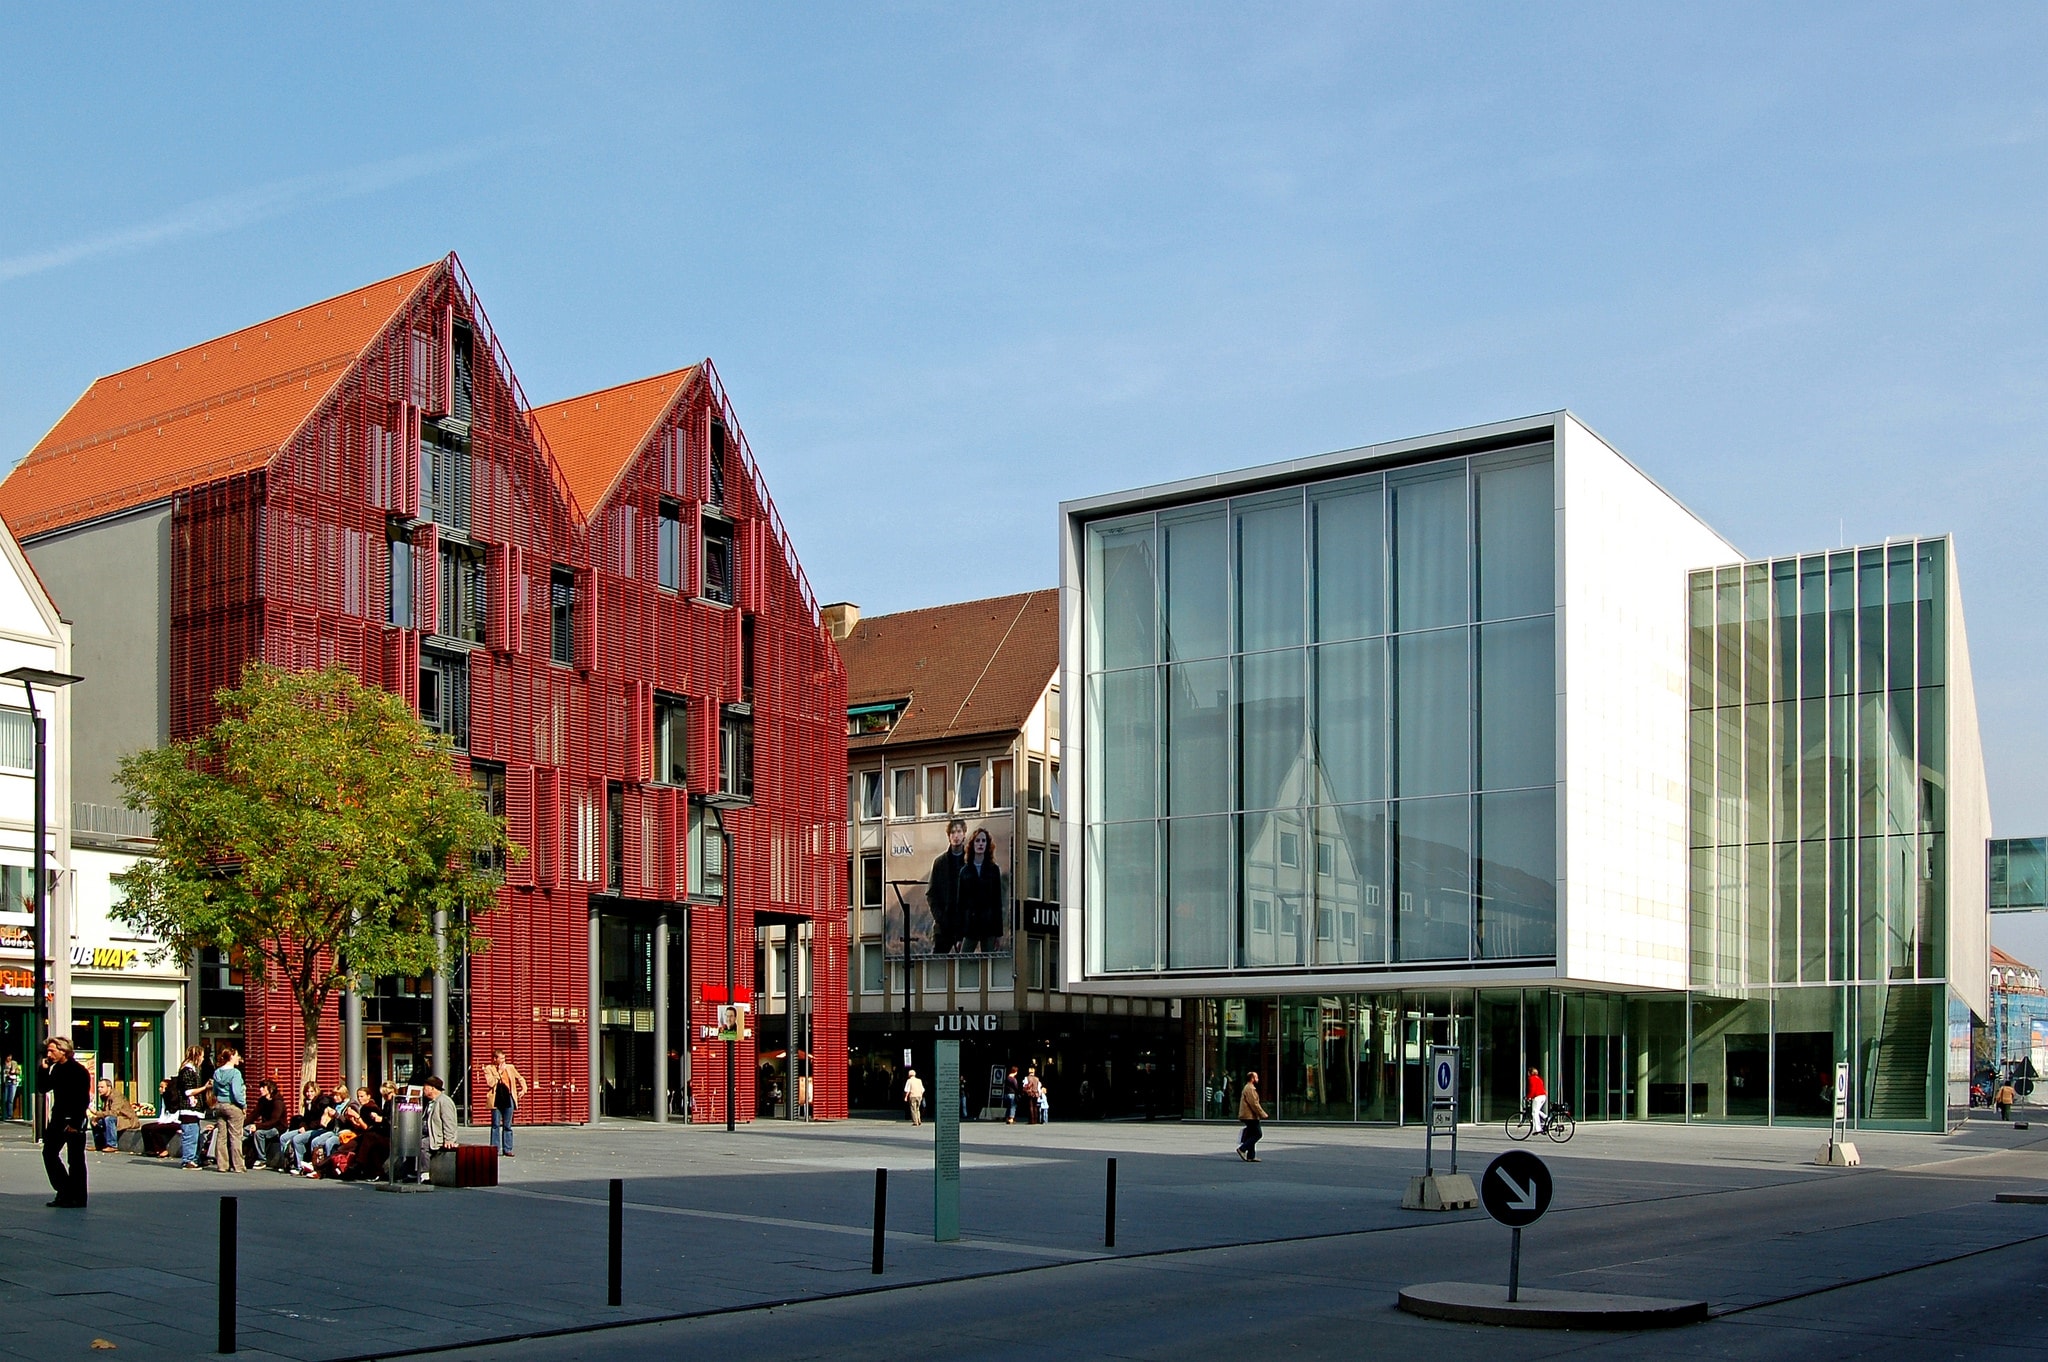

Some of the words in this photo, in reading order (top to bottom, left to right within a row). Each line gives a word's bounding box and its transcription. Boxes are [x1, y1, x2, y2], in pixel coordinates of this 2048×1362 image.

[1033, 908, 1060, 926] JUN
[70, 947, 138, 967] UBWAY
[0, 970, 32, 989] SHI
[934, 1014, 998, 1031] JUNG
